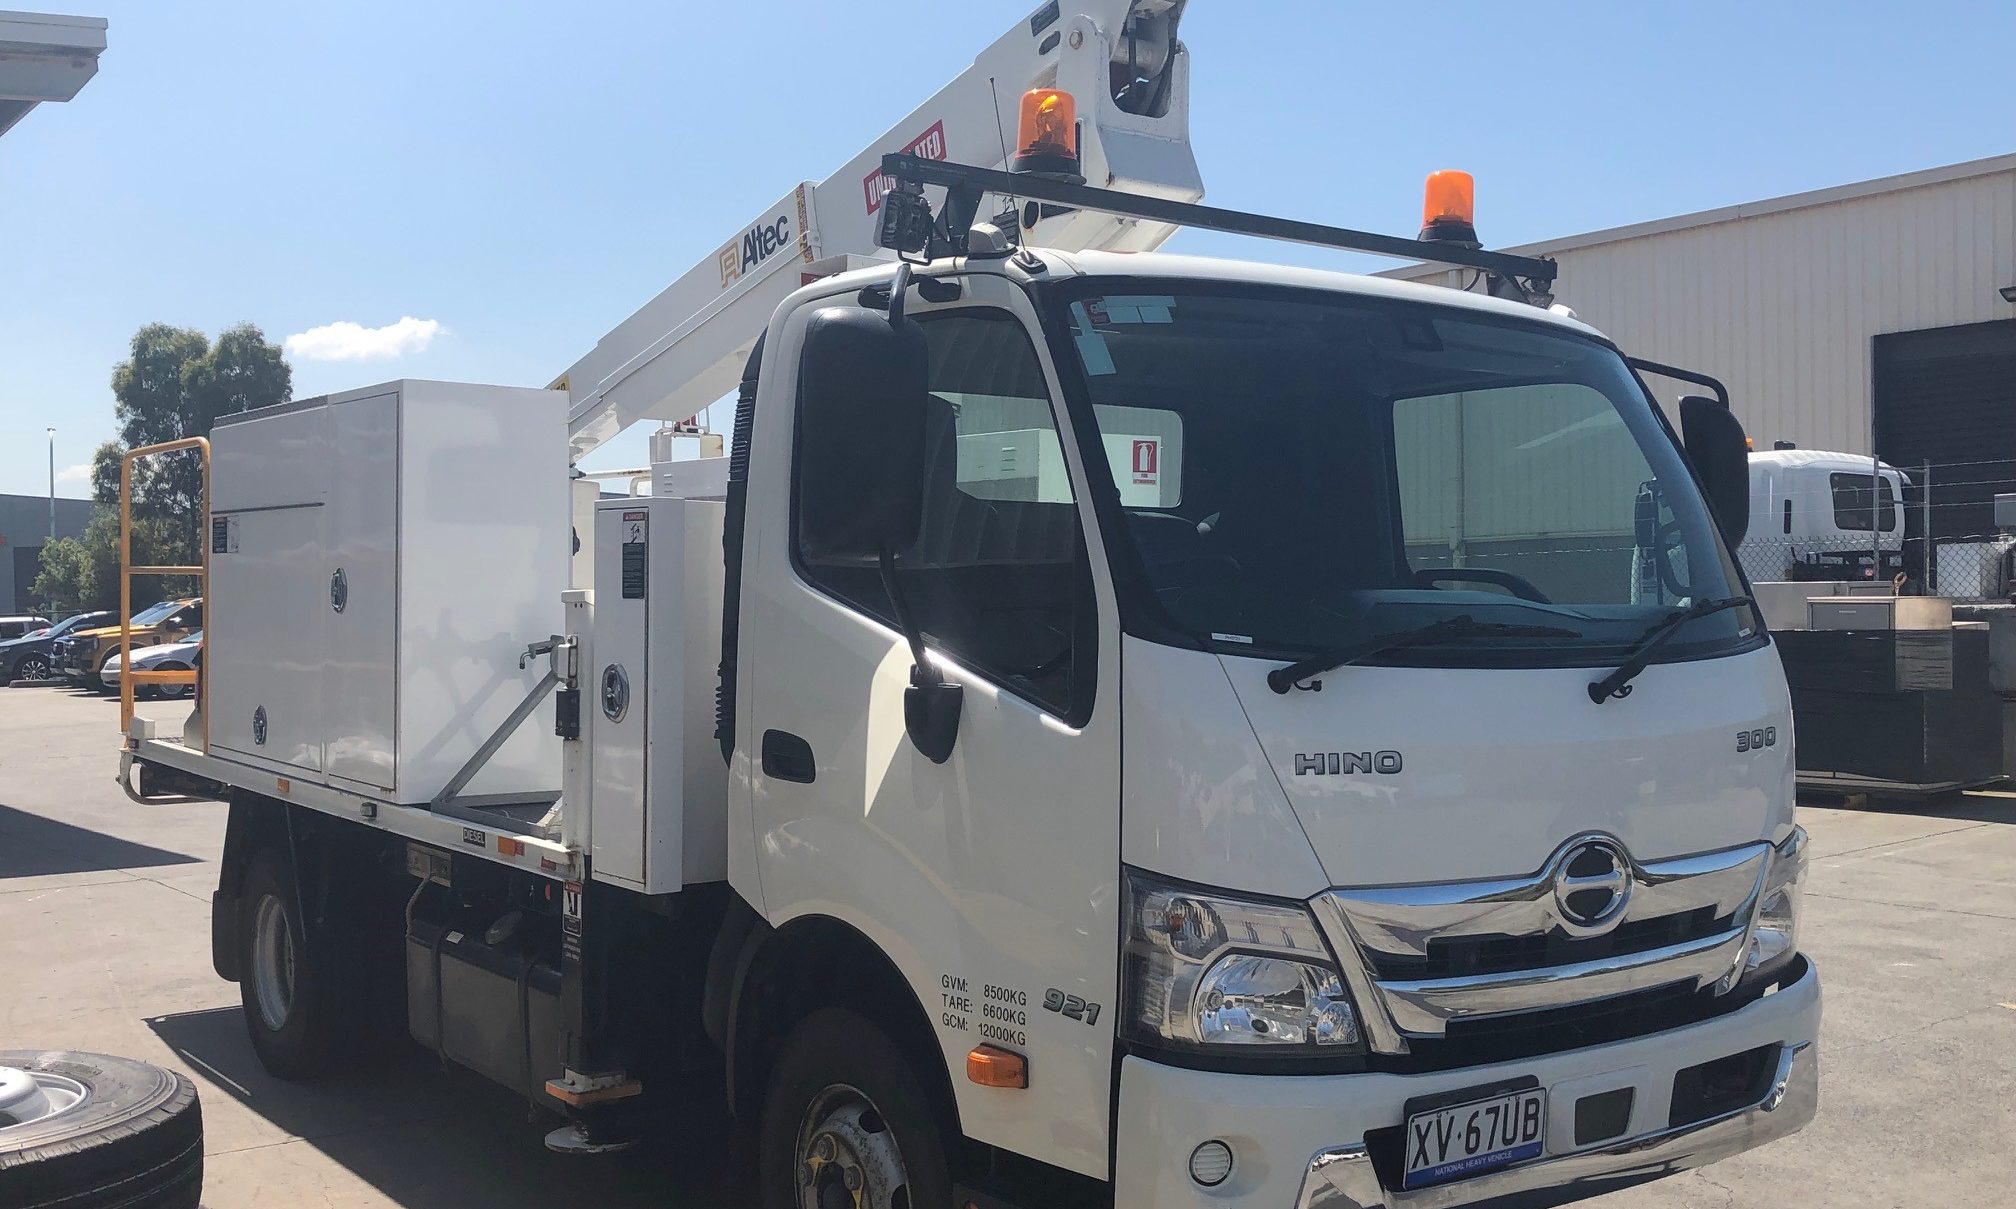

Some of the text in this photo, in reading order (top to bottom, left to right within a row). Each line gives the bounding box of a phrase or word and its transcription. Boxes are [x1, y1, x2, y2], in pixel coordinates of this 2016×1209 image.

[867, 130, 941, 206] UNINTED
[741, 215, 790, 275] Altec
[1736, 726, 1776, 753] 300
[1294, 750, 1403, 776] HINO
[463, 828, 486, 844] DIESEL
[941, 974, 1027, 1006] GVM: 8500KG
[941, 993, 1026, 1026] TARE: 6600KG
[1042, 987, 1102, 1026] 921
[941, 1012, 1026, 1046] GCM: 12000KG
[1434, 1151, 1513, 1176] NATIONAL HEAVY VEHICLE
